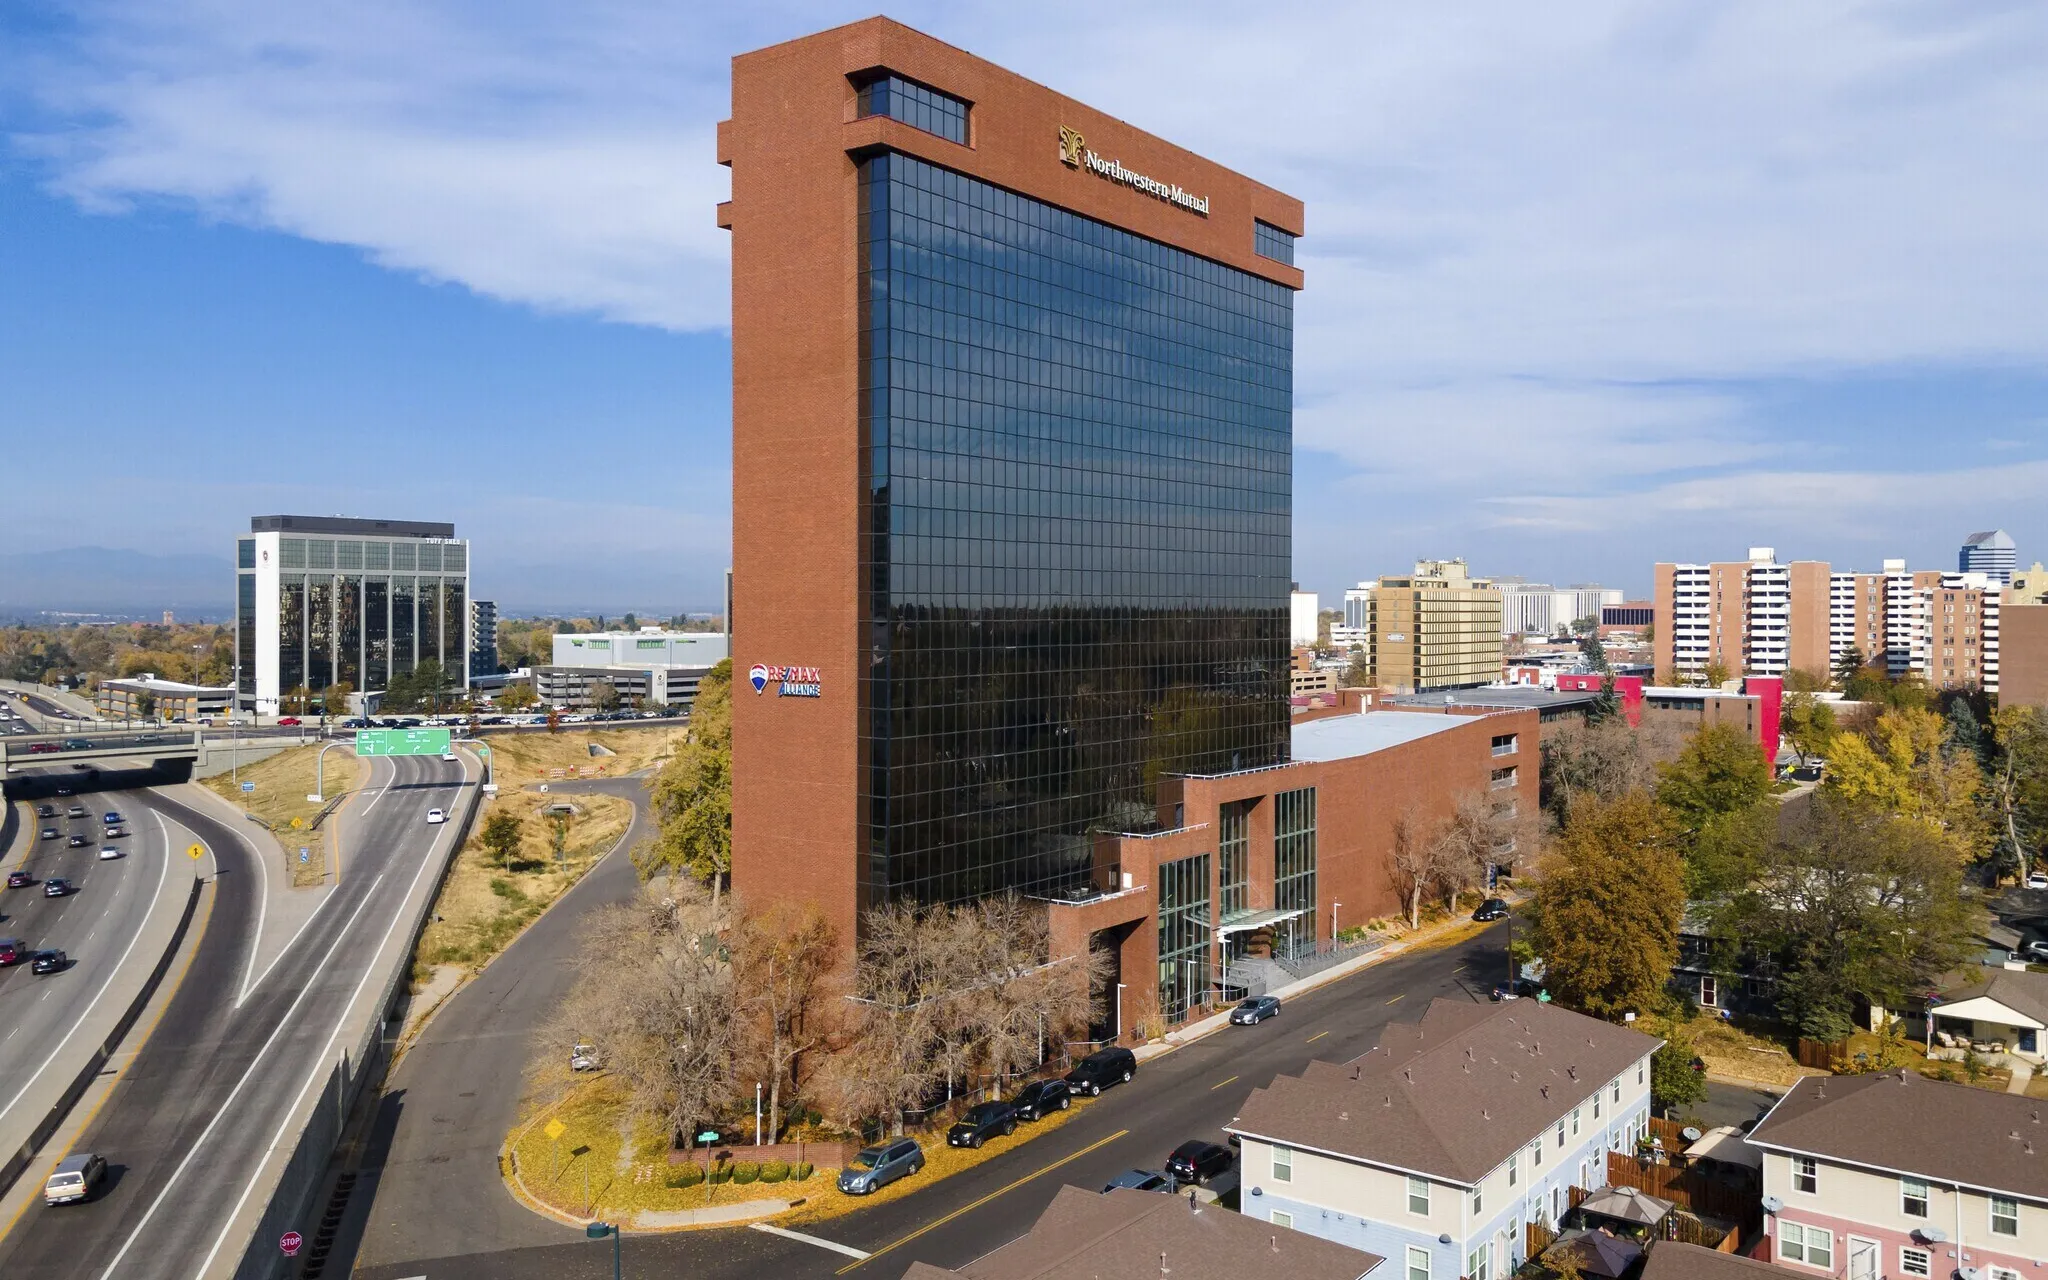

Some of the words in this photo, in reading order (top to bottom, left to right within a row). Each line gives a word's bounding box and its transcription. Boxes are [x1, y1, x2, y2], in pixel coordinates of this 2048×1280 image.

[1086, 149, 1169, 198] Northwestern
[1171, 184, 1210, 214] Mutual
[768, 665, 820, 683] RE/MAX
[777, 681, 820, 697] ALLIANCE
[281, 1237, 300, 1247] STOP
